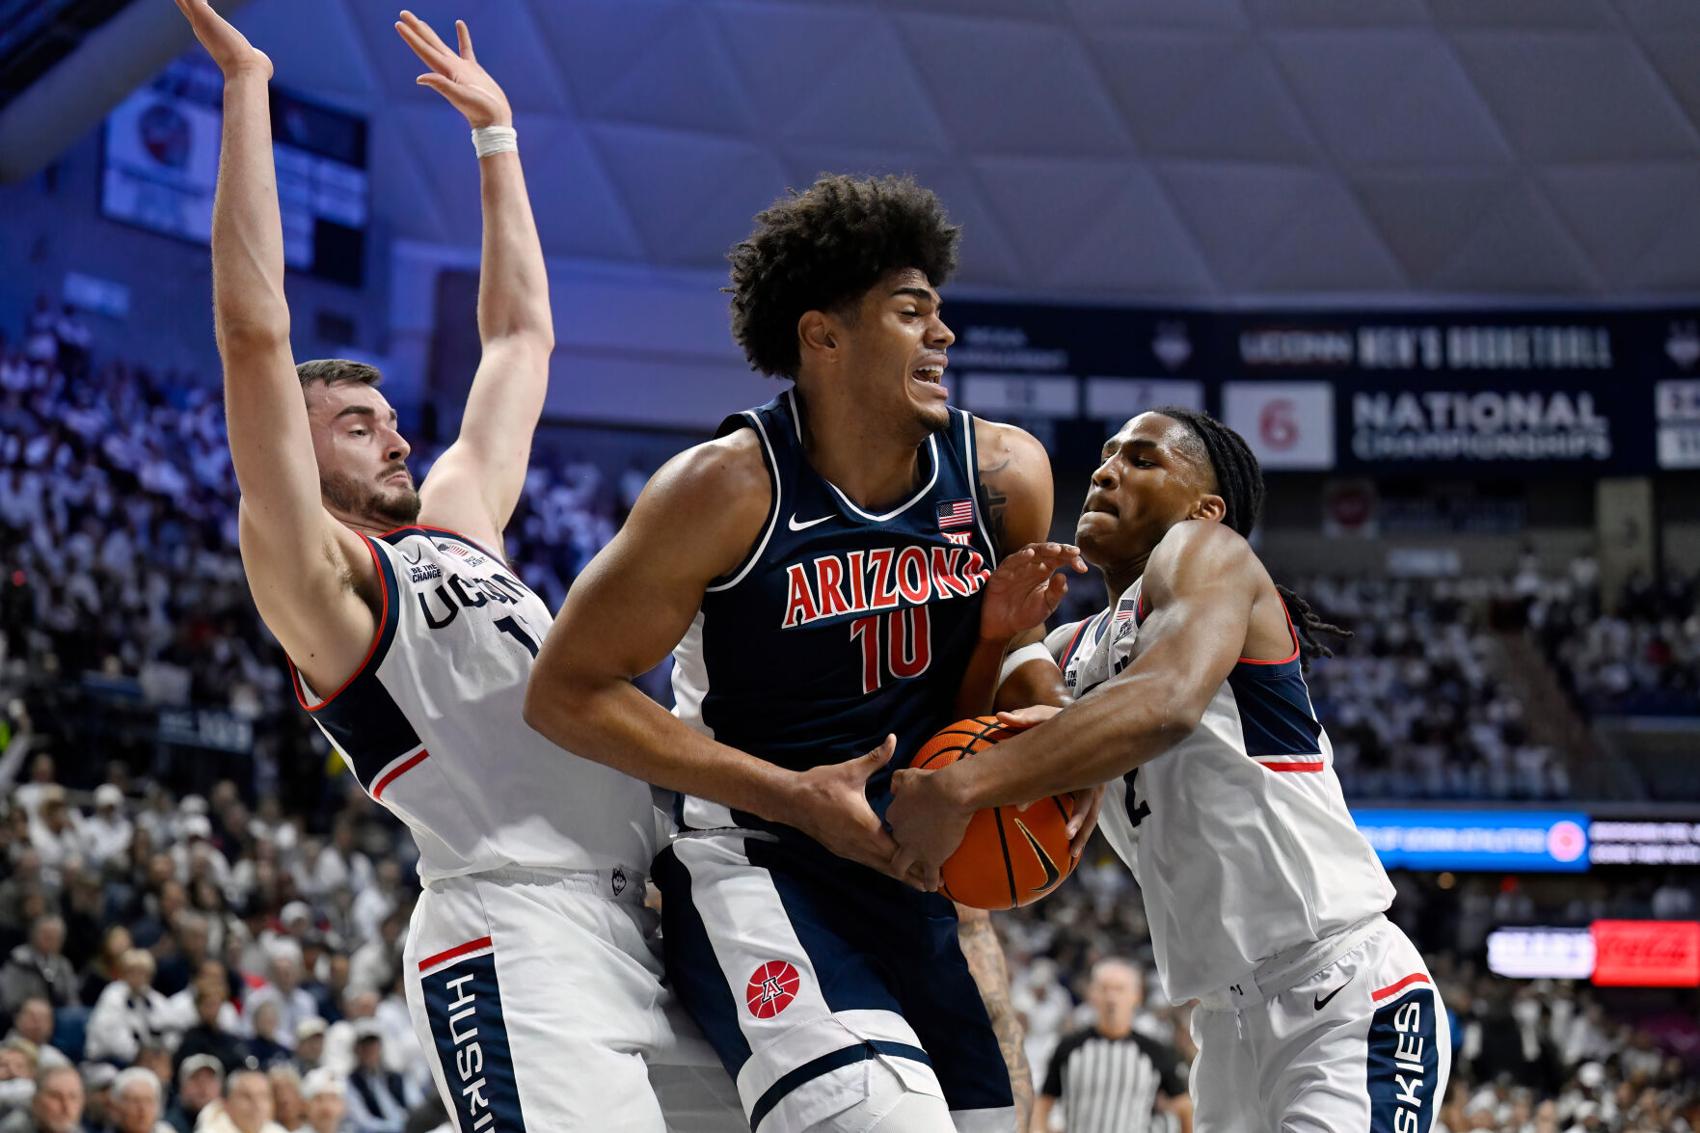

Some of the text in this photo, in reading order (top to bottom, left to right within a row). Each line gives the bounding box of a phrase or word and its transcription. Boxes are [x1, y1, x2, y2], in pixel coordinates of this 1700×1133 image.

[1258, 399, 1300, 451] 6
[1352, 392, 1607, 429] NATIONAL
[1351, 426, 1612, 460] CHAMPIONSHIPS
[412, 568, 442, 583] CHANGE
[423, 563, 438, 572] THE
[781, 545, 992, 629] ARIZONA
[849, 603, 932, 695] 10
